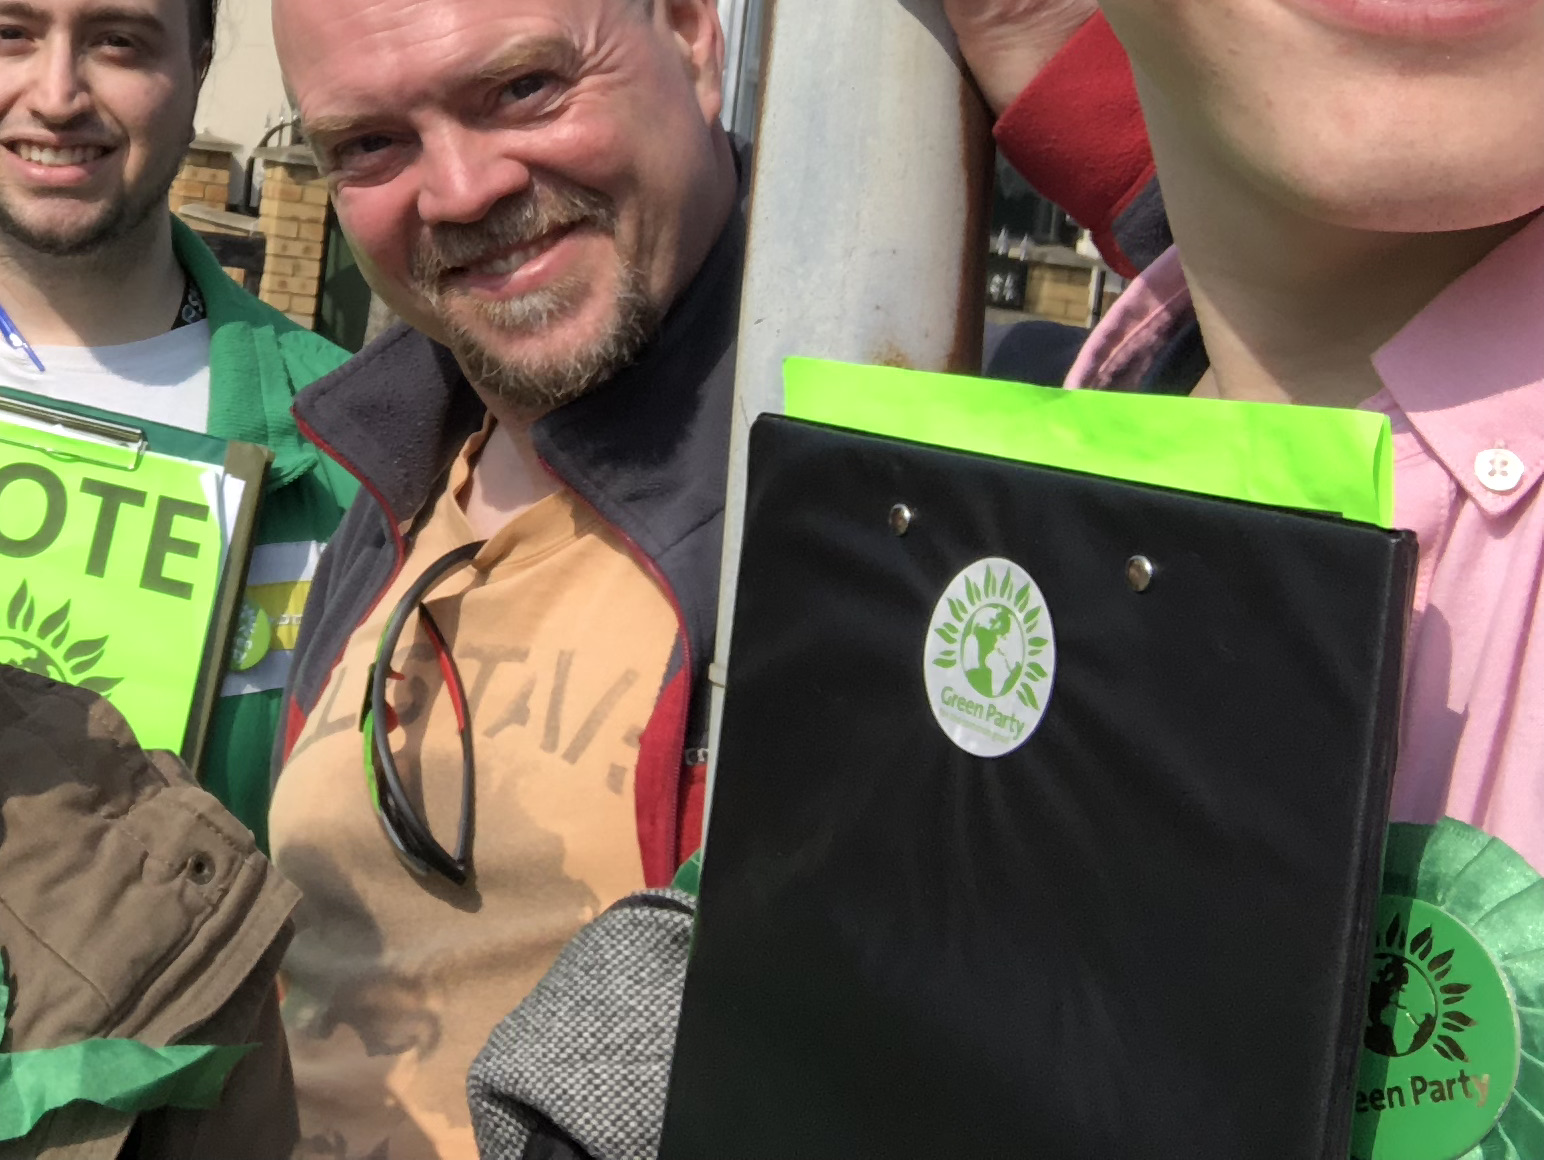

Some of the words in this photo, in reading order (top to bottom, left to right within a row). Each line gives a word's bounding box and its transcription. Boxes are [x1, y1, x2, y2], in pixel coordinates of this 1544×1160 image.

[940, 686, 984, 719] Green
[985, 703, 1025, 740] Party
[1355, 1083, 1405, 1113] een
[1409, 1068, 1491, 1108] Party
